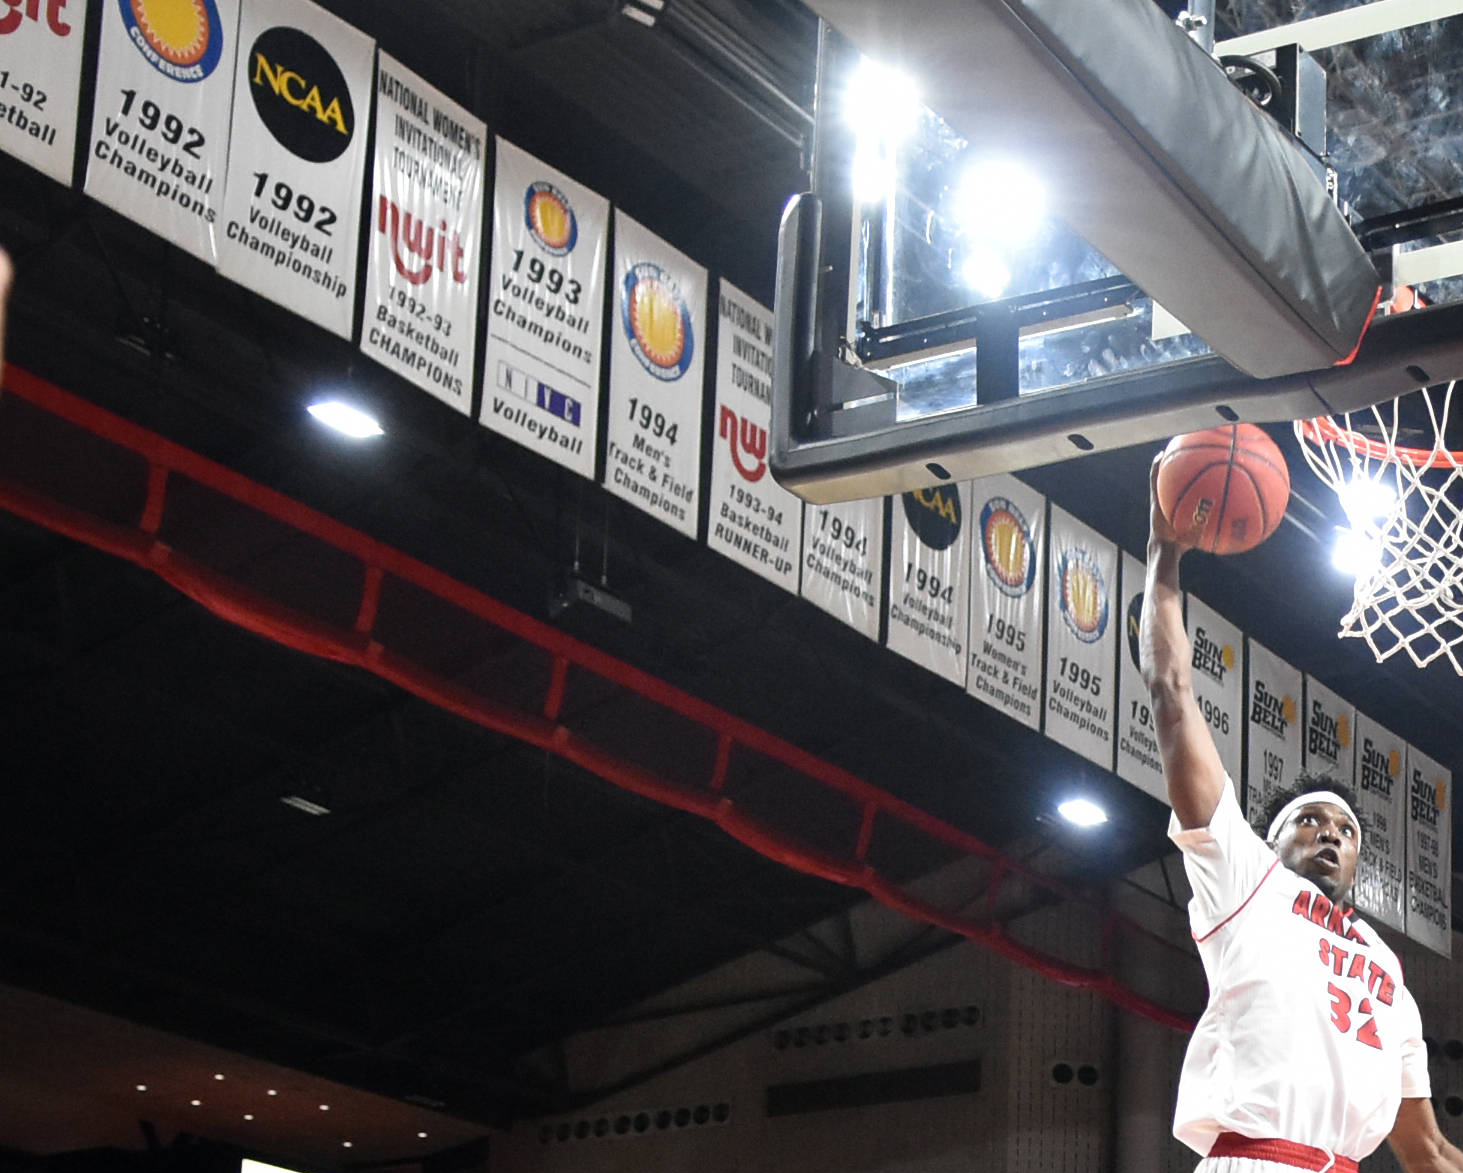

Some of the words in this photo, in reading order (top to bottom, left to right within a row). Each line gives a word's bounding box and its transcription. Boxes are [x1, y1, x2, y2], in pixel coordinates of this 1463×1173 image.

[252, 53, 349, 136] NCAA
[380, 70, 429, 125] NATIONAL
[433, 107, 480, 160] WOMEN'S
[121, 88, 206, 160] 1992
[104, 117, 214, 194] Volleyball
[94, 140, 216, 223] Champions
[252, 172, 338, 236] 1992
[248, 205, 334, 265] Volleyball
[378, 195, 467, 285] nwit
[226, 220, 348, 299] Championship
[513, 249, 582, 305] 1993
[389, 286, 452, 337] 1992-93
[502, 273, 590, 334] Volleyball
[376, 304, 459, 367] Basketball
[493, 298, 592, 364] Champions
[369, 327, 463, 396] CHAMPIONS
[493, 397, 583, 455] Volleyball
[628, 397, 678, 446] 1994
[632, 434, 671, 468] Men's
[614, 467, 685, 521] Champions
[648, 465, 657, 481] &
[662, 477, 694, 503] Field
[729, 484, 783, 525] 1993-94
[911, 489, 957, 524] CAA
[714, 523, 793, 576] RUNNER-UP
[720, 502, 789, 551] Basketball
[819, 509, 867, 557] 1994
[806, 554, 875, 608] Champions
[812, 537, 873, 584] Volleyball
[905, 562, 954, 604] 1994
[890, 603, 962, 656] Championship
[987, 614, 1026, 652] 1995
[1194, 627, 1223, 663] SUN
[970, 653, 998, 678] Track
[1013, 676, 1038, 701] Field
[983, 640, 1027, 676] Women's
[1060, 657, 1102, 696] 1995
[1191, 649, 1227, 681] BELT
[976, 676, 1031, 717] Champions
[1048, 698, 1109, 742] Champions
[1052, 680, 1107, 722] Volleyball
[1197, 696, 1229, 735] 1996
[1250, 702, 1288, 735] BELT
[1254, 681, 1284, 717] SUN
[1311, 699, 1339, 735] SUN
[1263, 749, 1284, 783] 1997
[1309, 726, 1341, 761] BELT
[1362, 738, 1390, 772] SUN
[1361, 764, 1394, 796] BELT
[1411, 770, 1437, 804] SUN
[1411, 796, 1440, 825] BELT
[1318, 938, 1396, 1006] STATE
